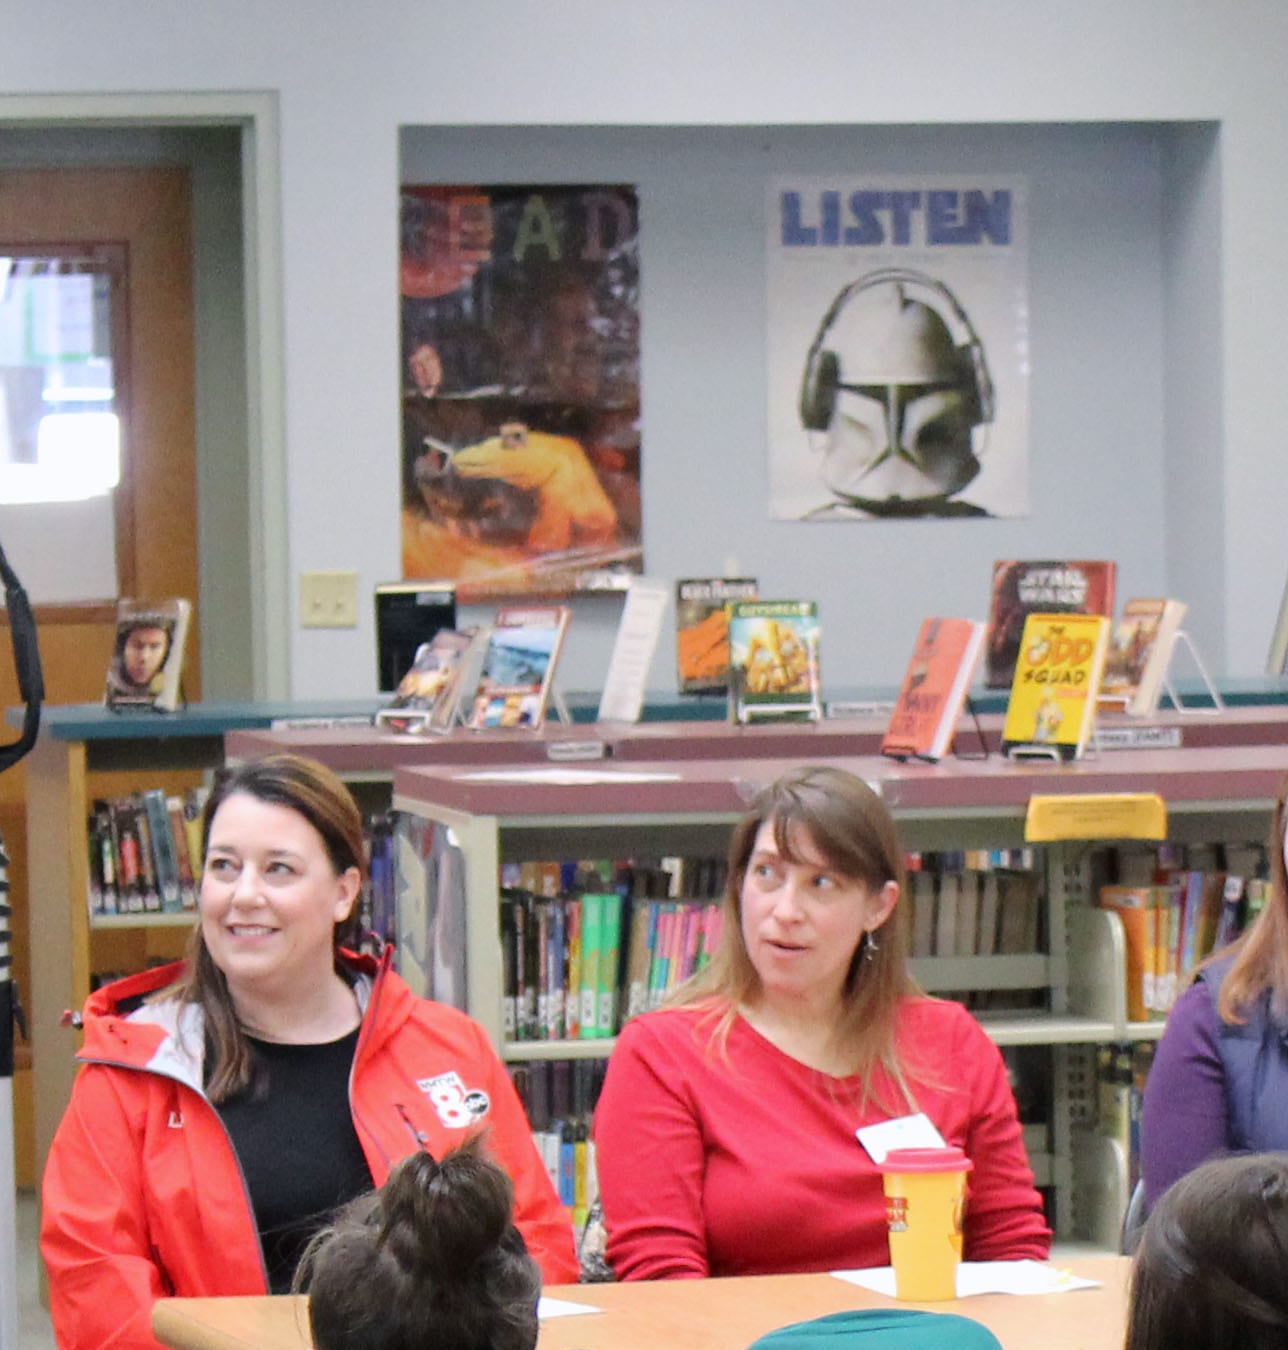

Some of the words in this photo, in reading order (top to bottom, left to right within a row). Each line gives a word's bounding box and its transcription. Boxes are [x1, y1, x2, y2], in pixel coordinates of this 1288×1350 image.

[780, 190, 1011, 246] LISTEN
[1020, 569, 1086, 587] STAR
[1018, 585, 1086, 604] WARS
[1027, 636, 1094, 667] ODD
[1023, 669, 1087, 685] SQUAD
